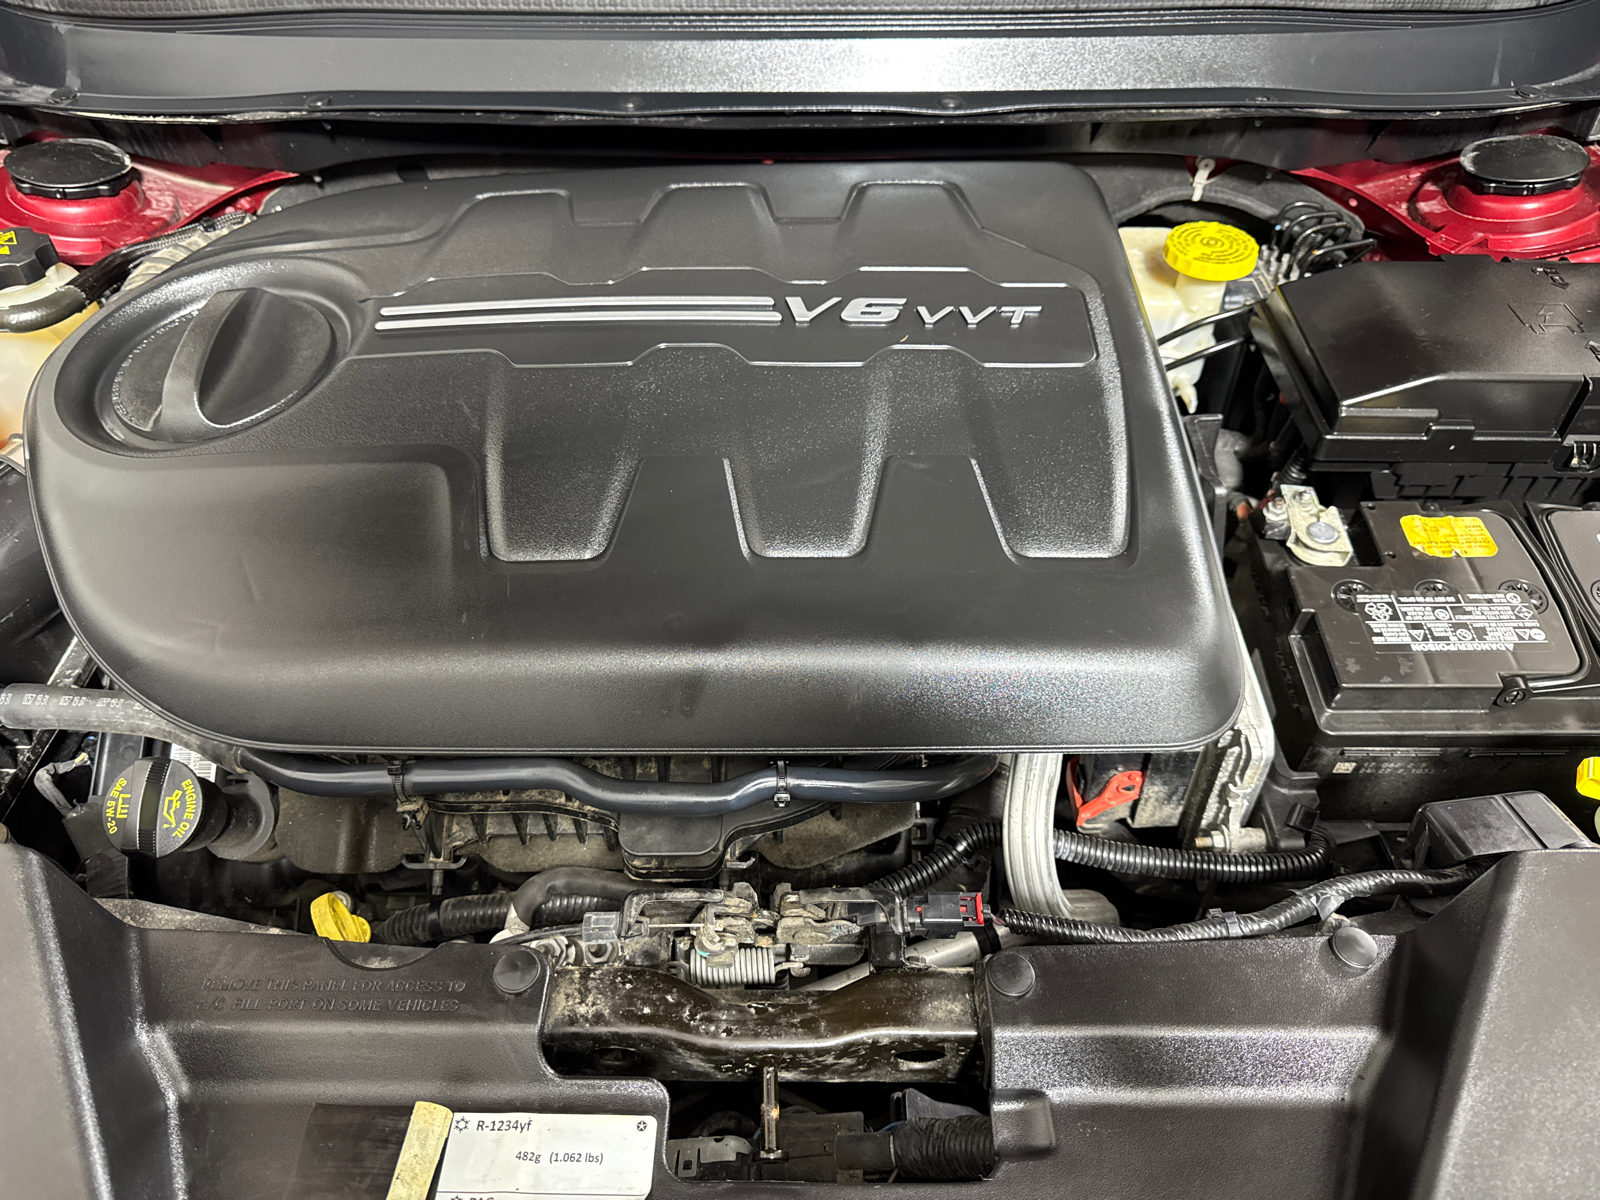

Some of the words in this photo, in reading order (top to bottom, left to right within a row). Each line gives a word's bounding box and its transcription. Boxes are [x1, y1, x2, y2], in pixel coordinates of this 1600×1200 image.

[785, 296, 907, 323] V6
[916, 305, 1042, 326] VVT
[1410, 643, 1507, 651] DANGER/POISON
[110, 777, 127, 798] SAE
[181, 778, 197, 821] ENGINE
[106, 800, 118, 834] 5W-20
[172, 821, 190, 838] OIL
[201, 978, 265, 992] REMOVE
[267, 979, 298, 991] THIS
[302, 979, 348, 992] PANEL
[353, 979, 384, 992] FOR
[386, 979, 443, 992] ACCESS
[448, 979, 467, 992] TO
[232, 999, 261, 1011] FILL
[268, 999, 304, 1011] PORT
[312, 999, 336, 1011] ON
[339, 999, 382, 1011] SOME
[388, 999, 460, 1011] VEHICLES
[476, 1118, 533, 1133] R-1234yf
[515, 1151, 542, 1164] 482g
[549, 1152, 582, 1164] (1.062
[584, 1152, 604, 1165] lbs)
